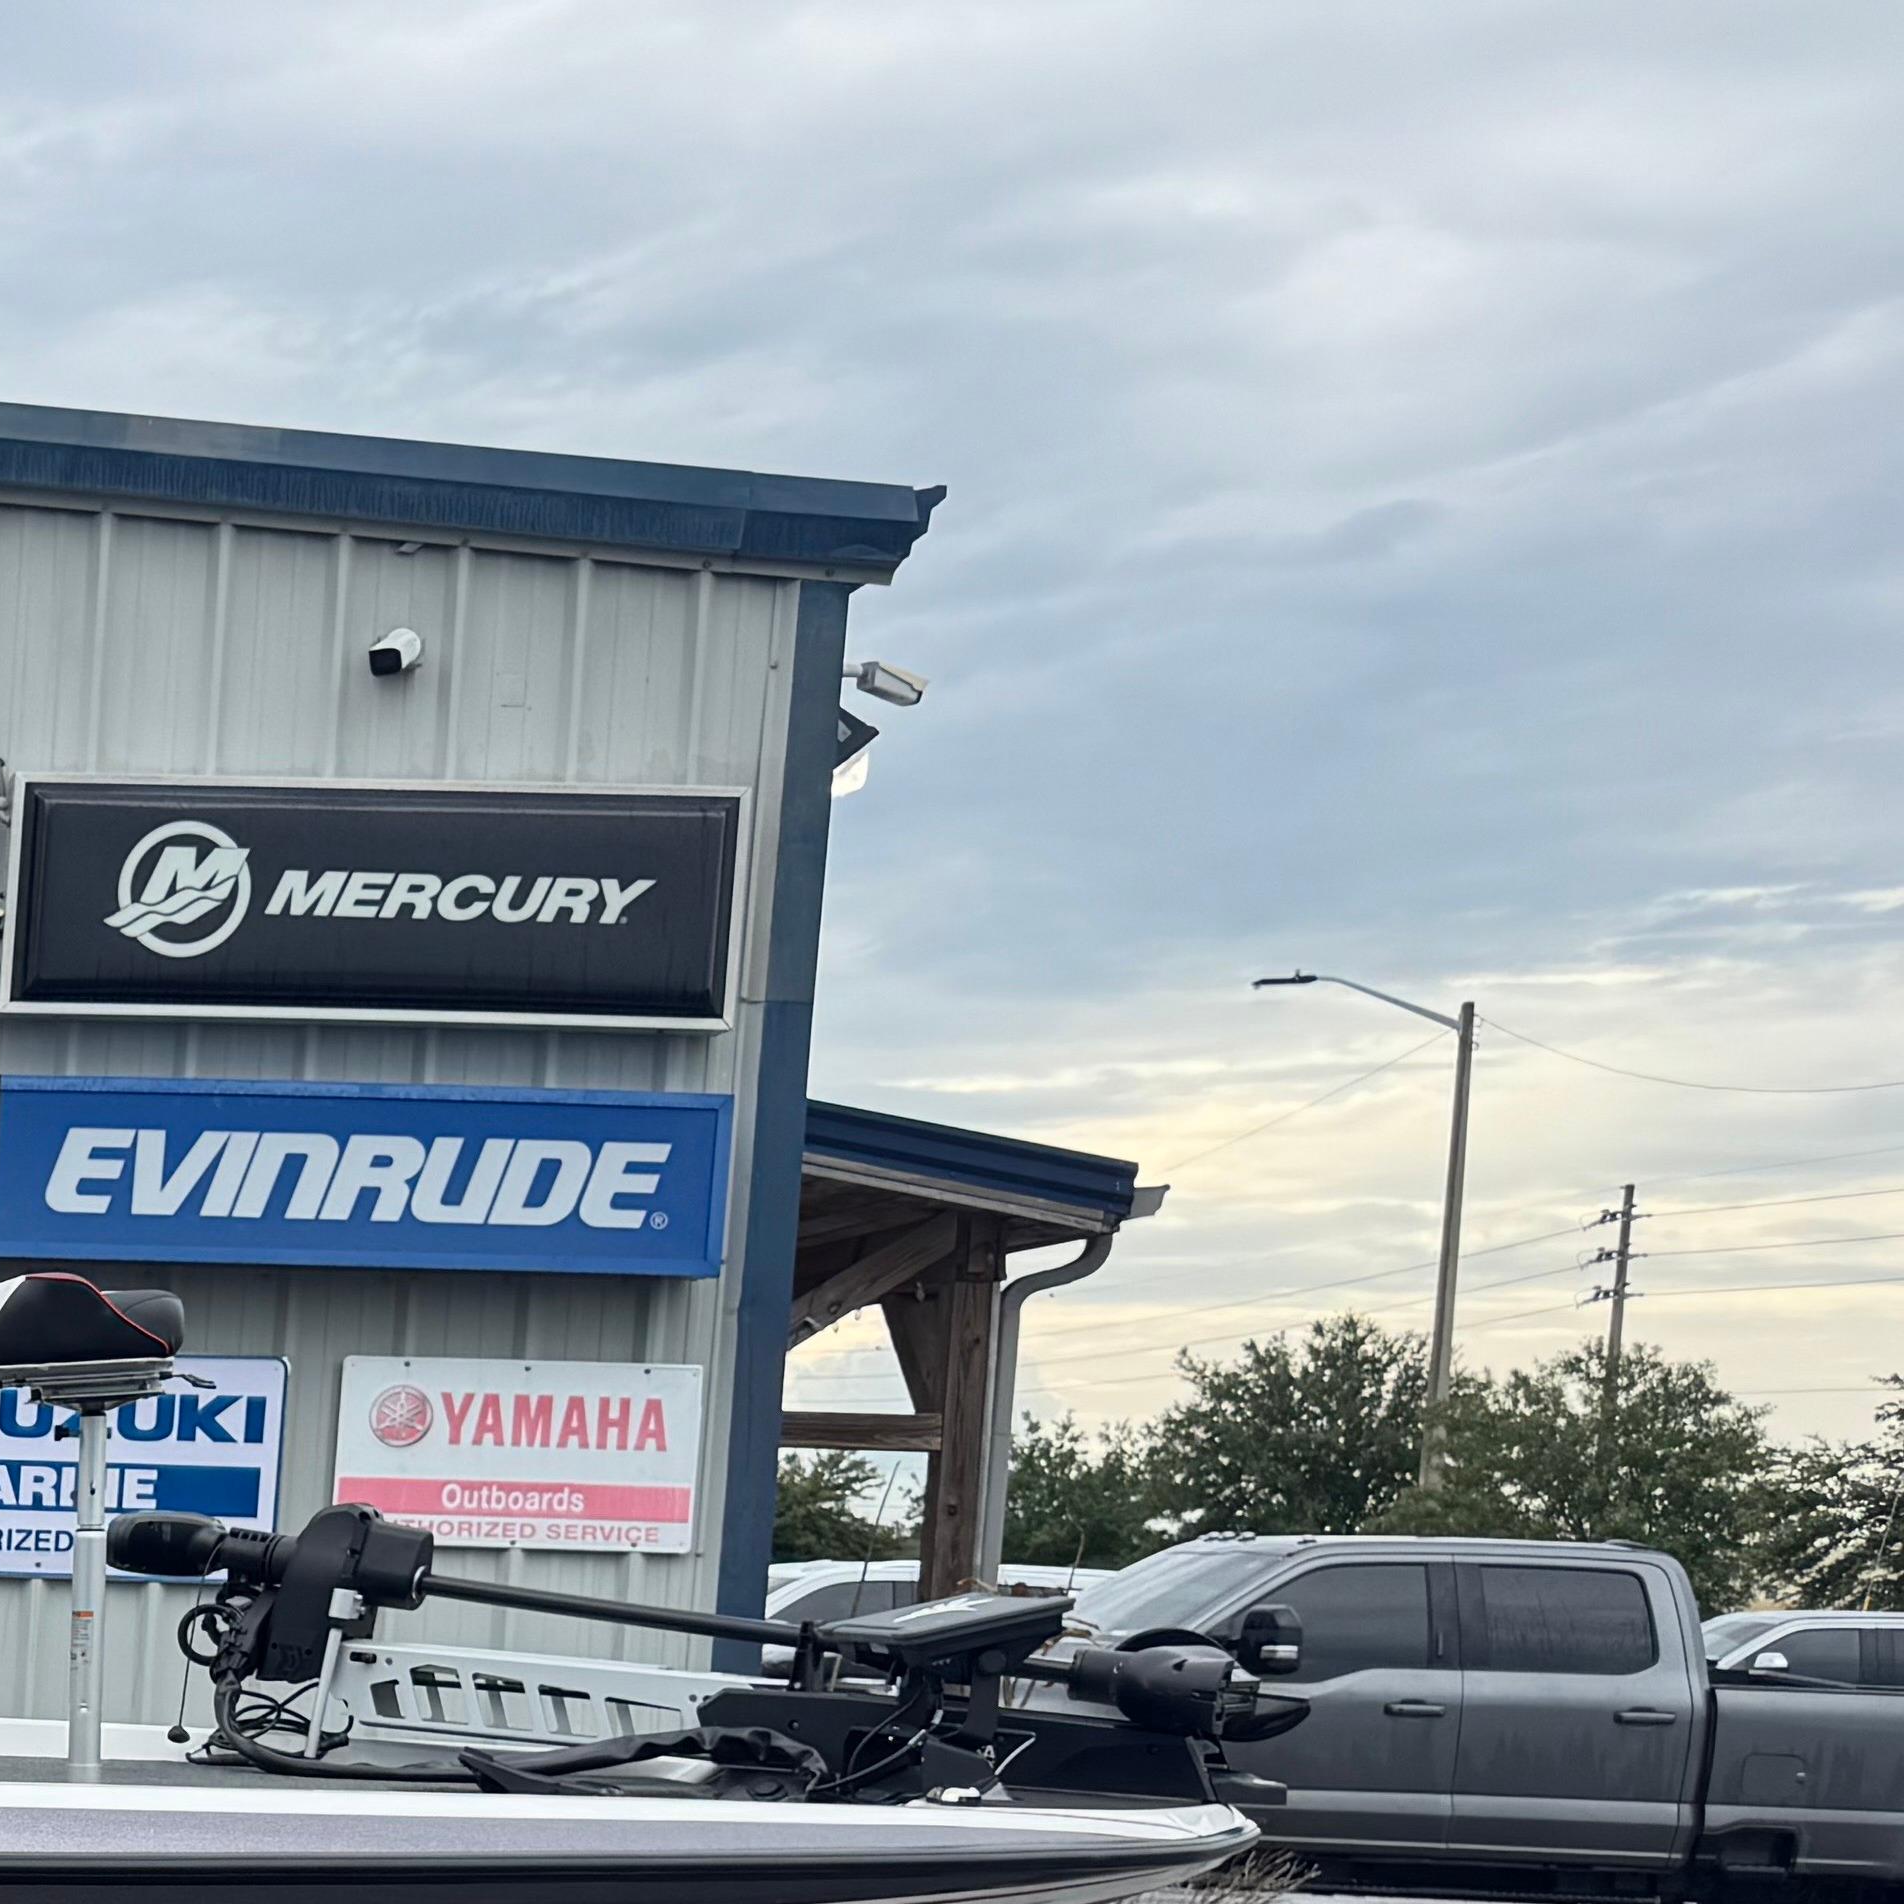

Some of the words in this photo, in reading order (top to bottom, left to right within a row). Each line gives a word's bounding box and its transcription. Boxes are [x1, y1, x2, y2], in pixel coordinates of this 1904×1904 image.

[264, 869, 656, 924] MERCURY
[44, 1127, 673, 1230] EVINRUDE
[440, 1391, 668, 1453] YAMAHA
[441, 1482, 585, 1513] Outboards
[545, 1523, 660, 1543] SERVICE
